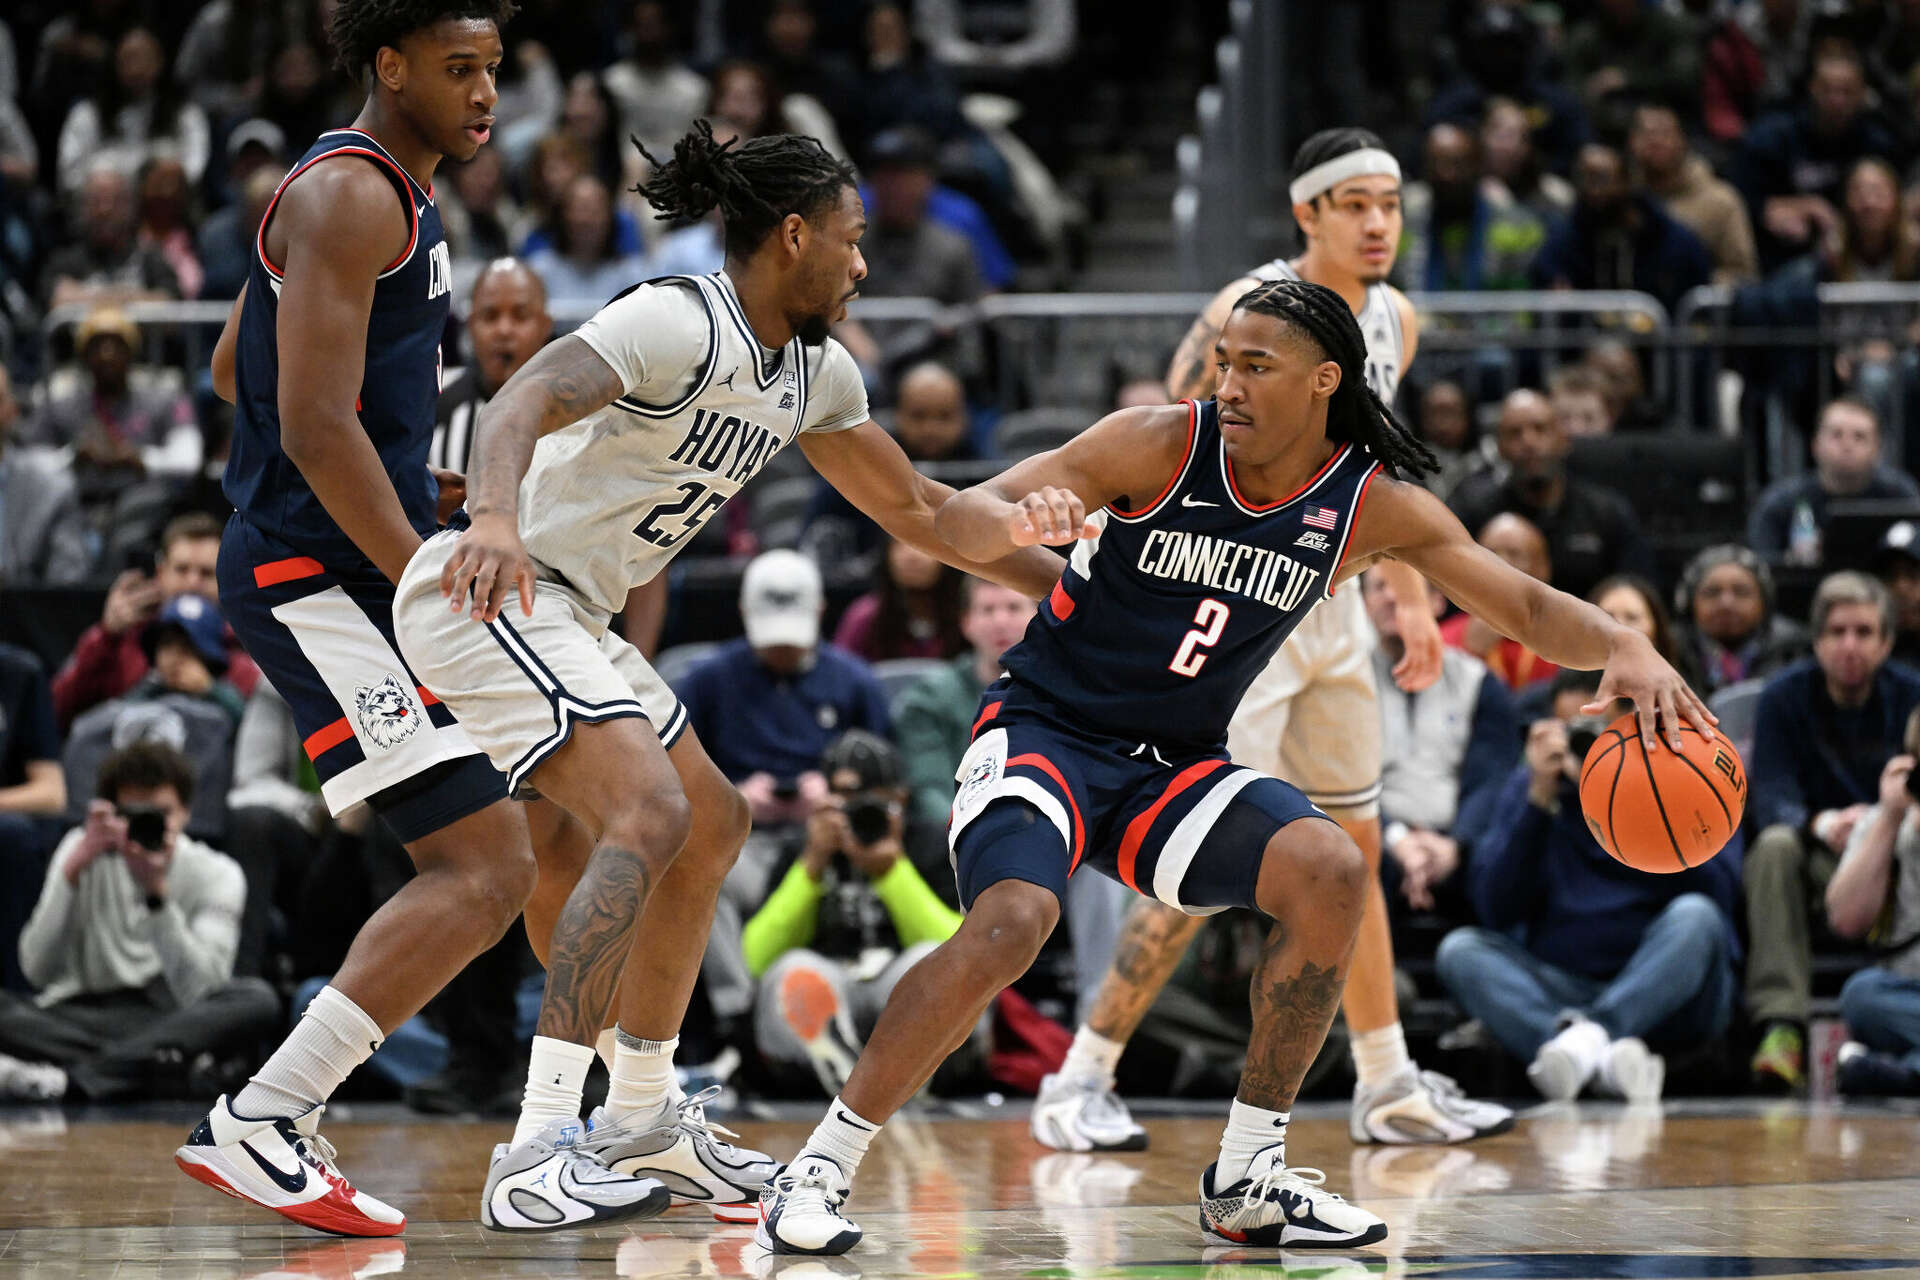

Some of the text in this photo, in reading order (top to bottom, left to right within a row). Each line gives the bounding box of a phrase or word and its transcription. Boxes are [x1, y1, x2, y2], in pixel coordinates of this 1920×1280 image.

[631, 481, 728, 548] 25
[1296, 536, 1331, 550] EAST
[1302, 531, 1328, 542] BIG
[1137, 529, 1320, 612] CONNECTICUT
[1168, 597, 1230, 678] 2
